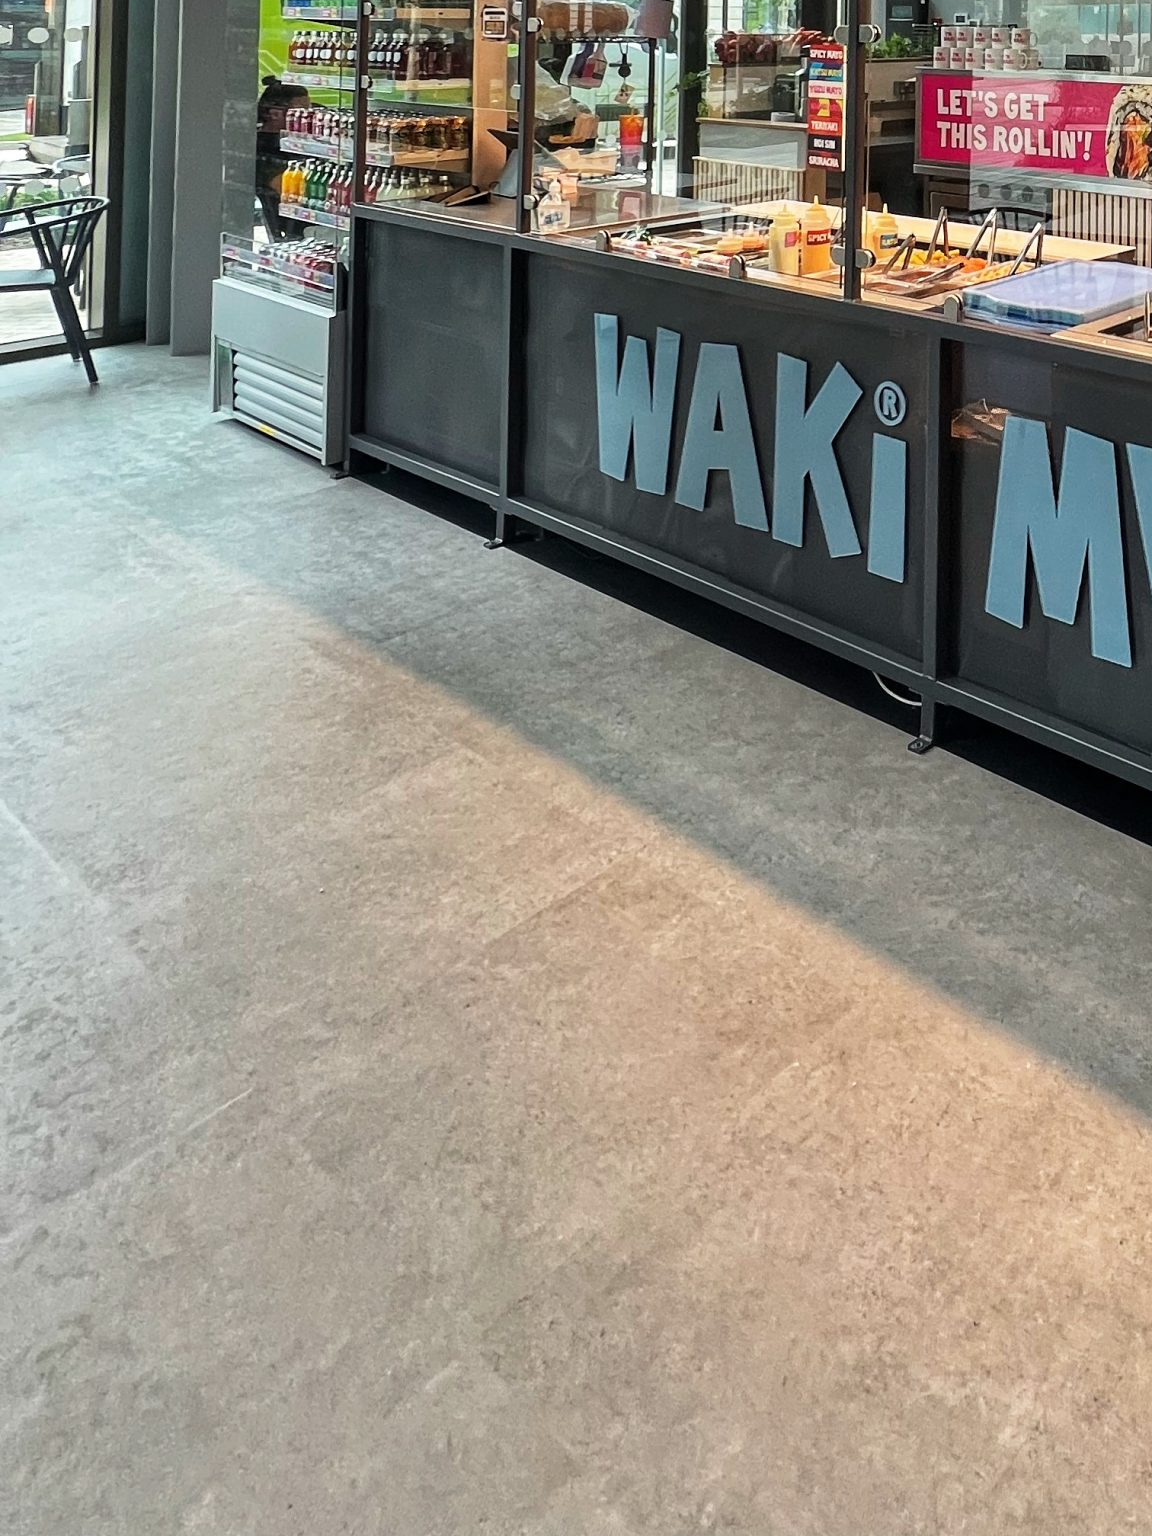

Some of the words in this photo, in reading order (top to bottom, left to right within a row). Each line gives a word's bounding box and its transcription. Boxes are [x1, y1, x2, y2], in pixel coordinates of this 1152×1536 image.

[809, 49, 826, 59] SPICY
[826, 50, 843, 59] MAYO
[937, 88, 998, 118] LET'S
[1004, 92, 1049, 122] GET
[811, 120, 839, 132] TERIYAKI
[936, 120, 988, 151] THIS
[992, 125, 1092, 162] ROLLIN'!
[808, 155, 840, 168] SRIRACHA
